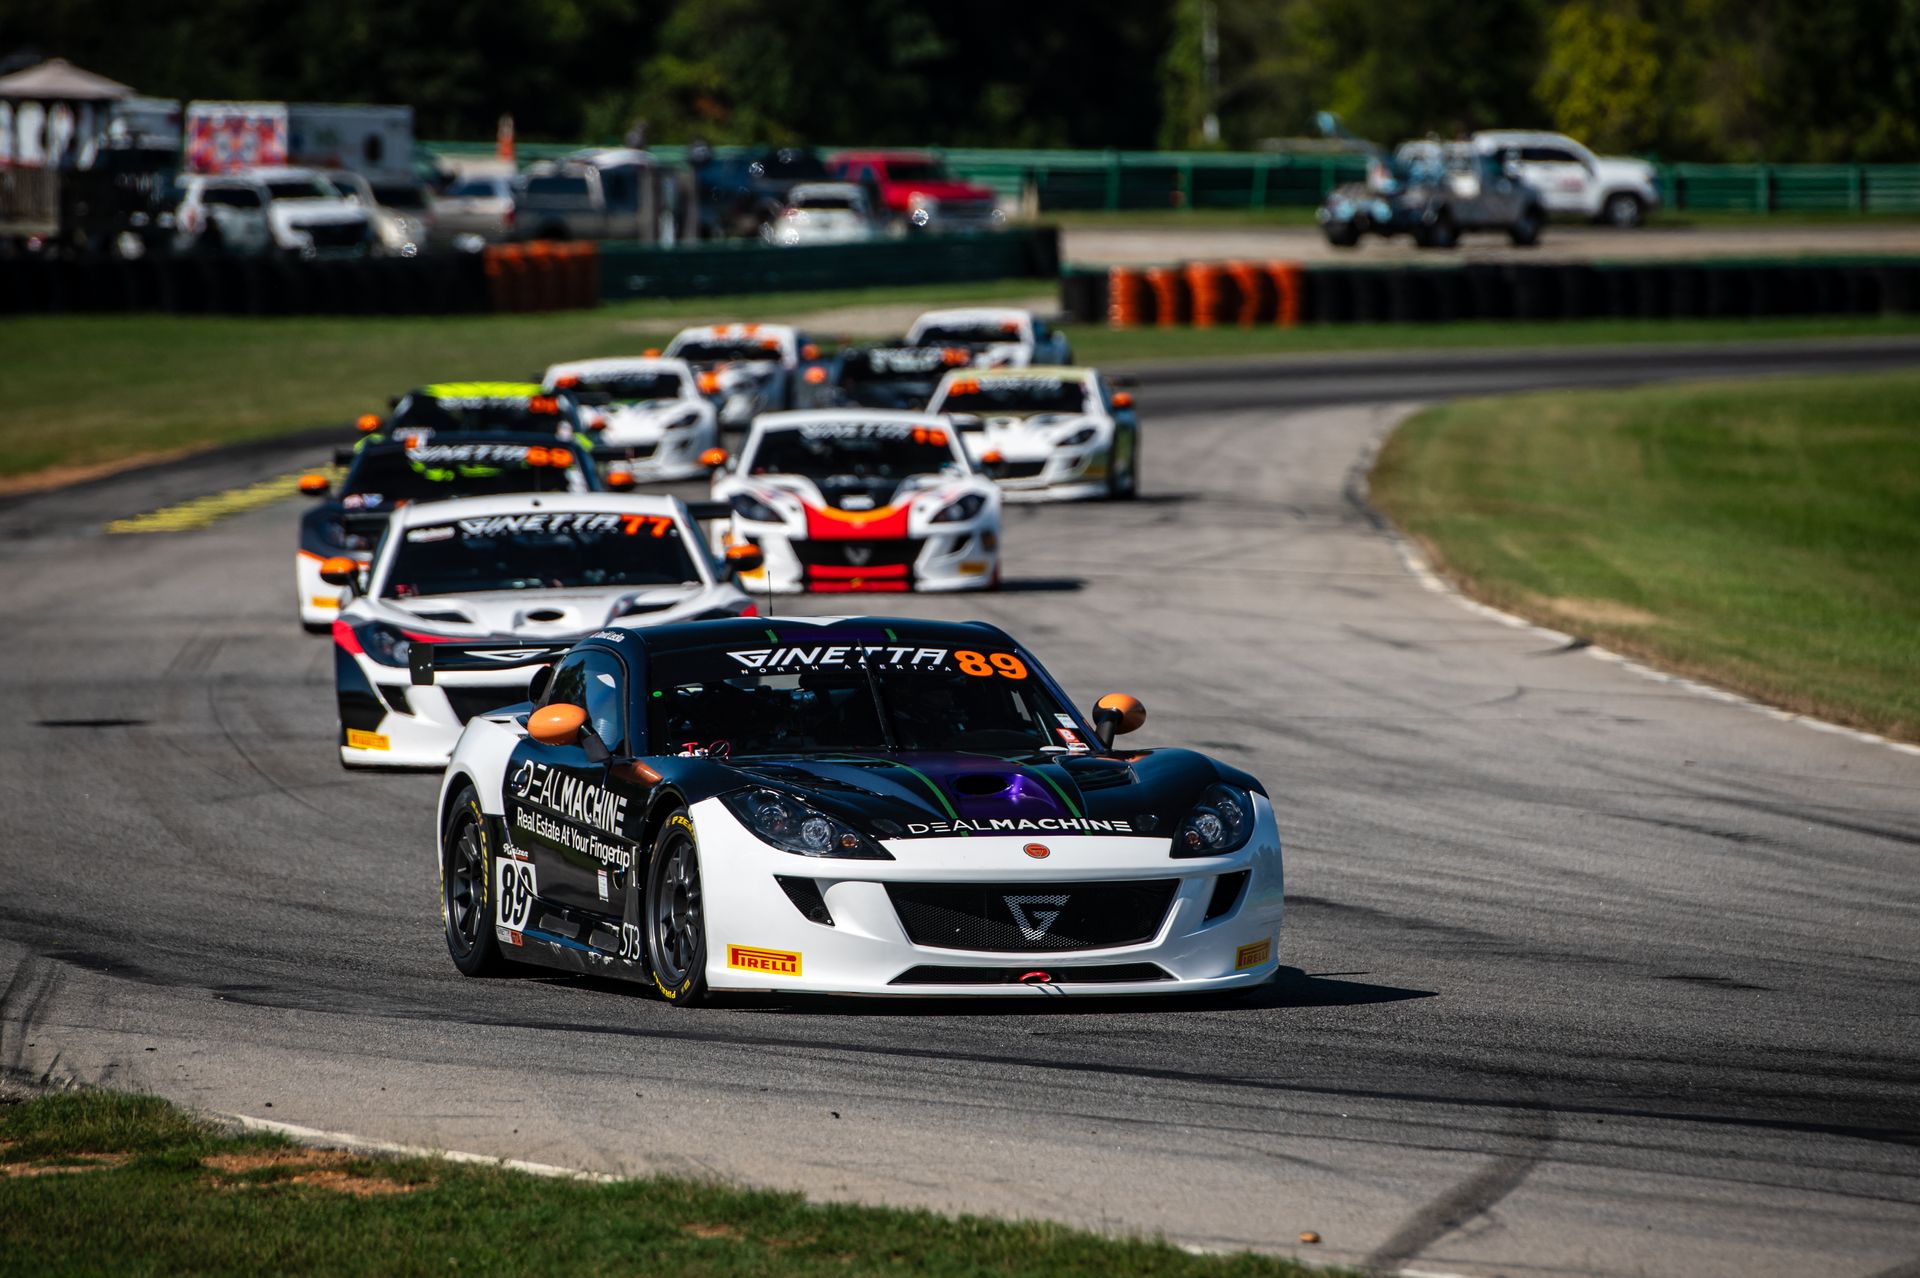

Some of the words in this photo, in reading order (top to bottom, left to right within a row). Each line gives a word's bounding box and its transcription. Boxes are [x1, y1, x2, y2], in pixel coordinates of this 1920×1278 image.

[459, 513, 619, 534] GINETTA
[620, 514, 673, 538] 77
[727, 647, 948, 667] GINETTA
[953, 650, 1028, 680] 89
[741, 664, 820, 675] NORTH
[514, 759, 628, 837] DEALMACHINE
[517, 806, 536, 833] Real
[536, 812, 560, 843] Estate
[560, 824, 570, 847] At
[571, 827, 590, 853] Your
[589, 834, 631, 872] Fingertip
[907, 818, 1134, 835] DEALMACHINE
[501, 863, 533, 926] 89
[619, 921, 641, 960] ST3
[1237, 941, 1270, 968] PIRELLI
[731, 947, 797, 973] PIRELLI
